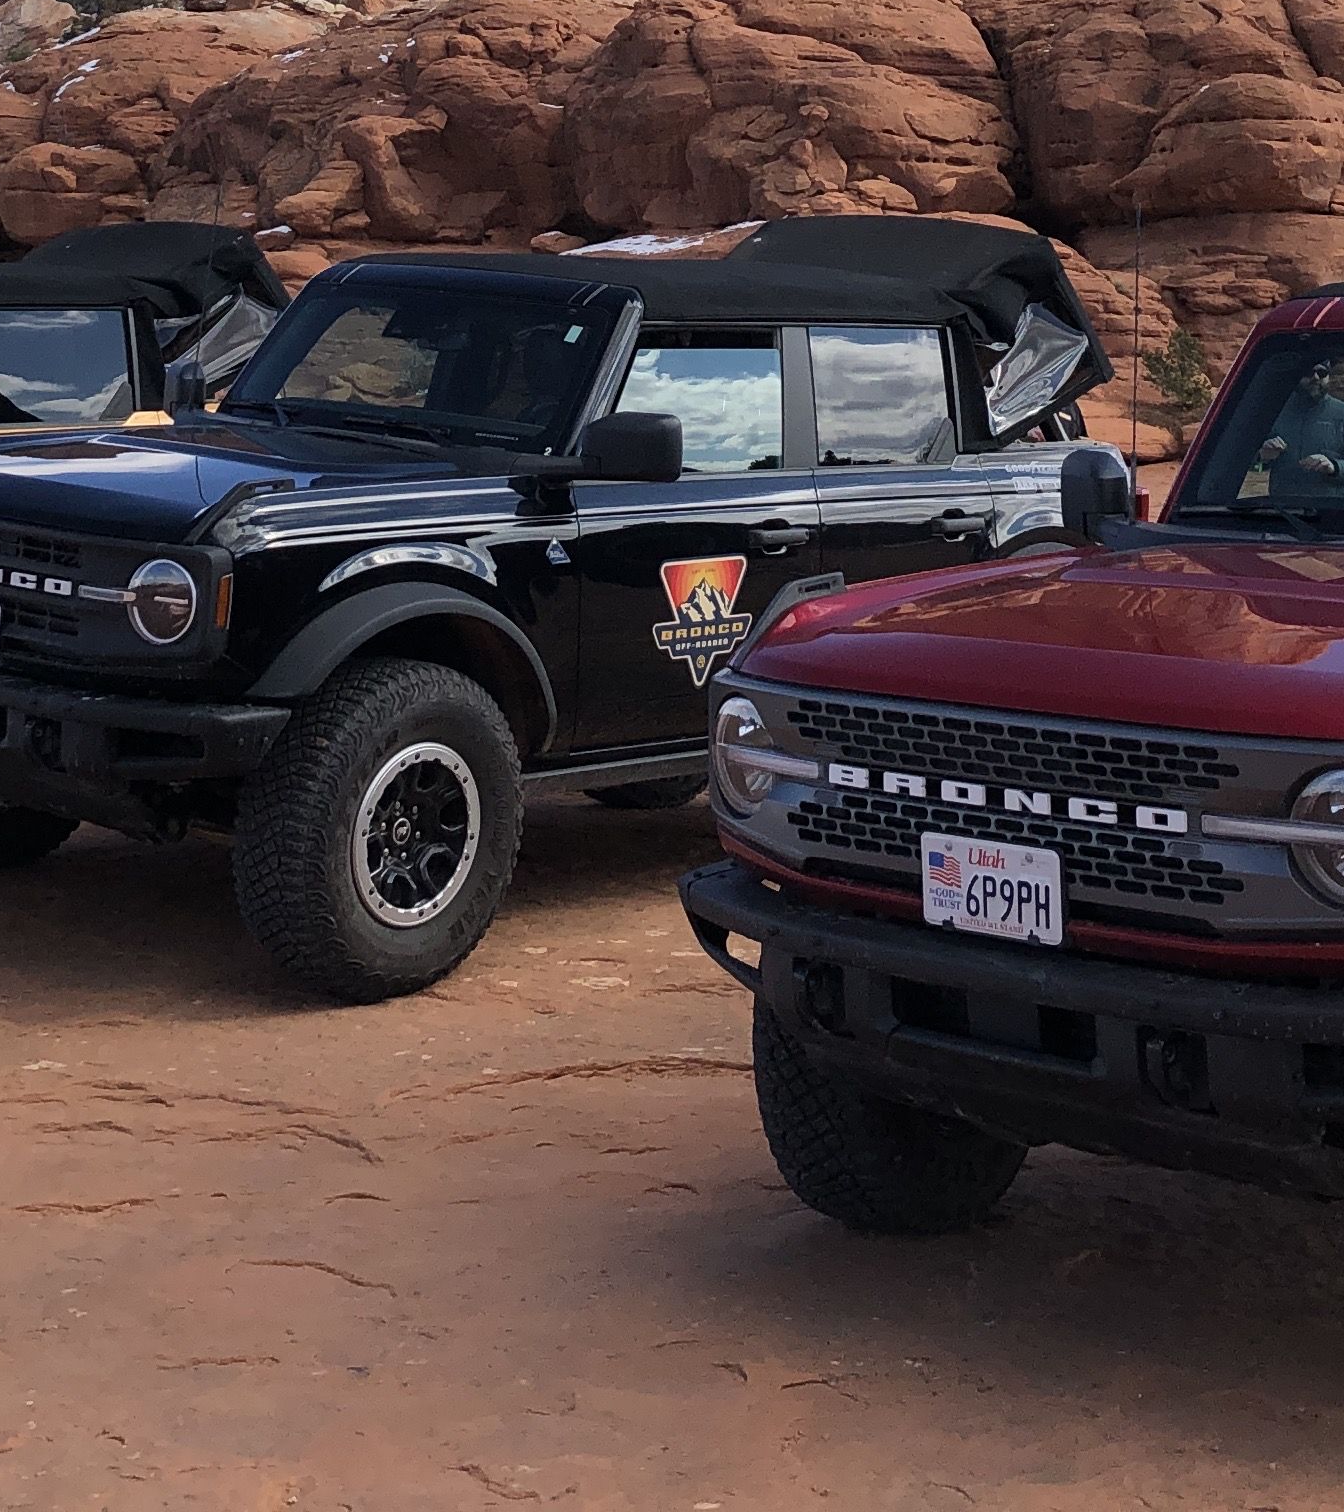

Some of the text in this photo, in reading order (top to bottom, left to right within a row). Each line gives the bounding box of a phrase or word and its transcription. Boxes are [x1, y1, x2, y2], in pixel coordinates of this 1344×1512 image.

[543, 446, 553, 457] 2
[661, 622, 744, 641] BRONCO
[828, 762, 1188, 834] BRONCO
[968, 847, 1006, 870] Utah
[936, 887, 955, 899] GOD
[966, 874, 1050, 930] 6P9PH
[932, 897, 961, 911] TRUST
